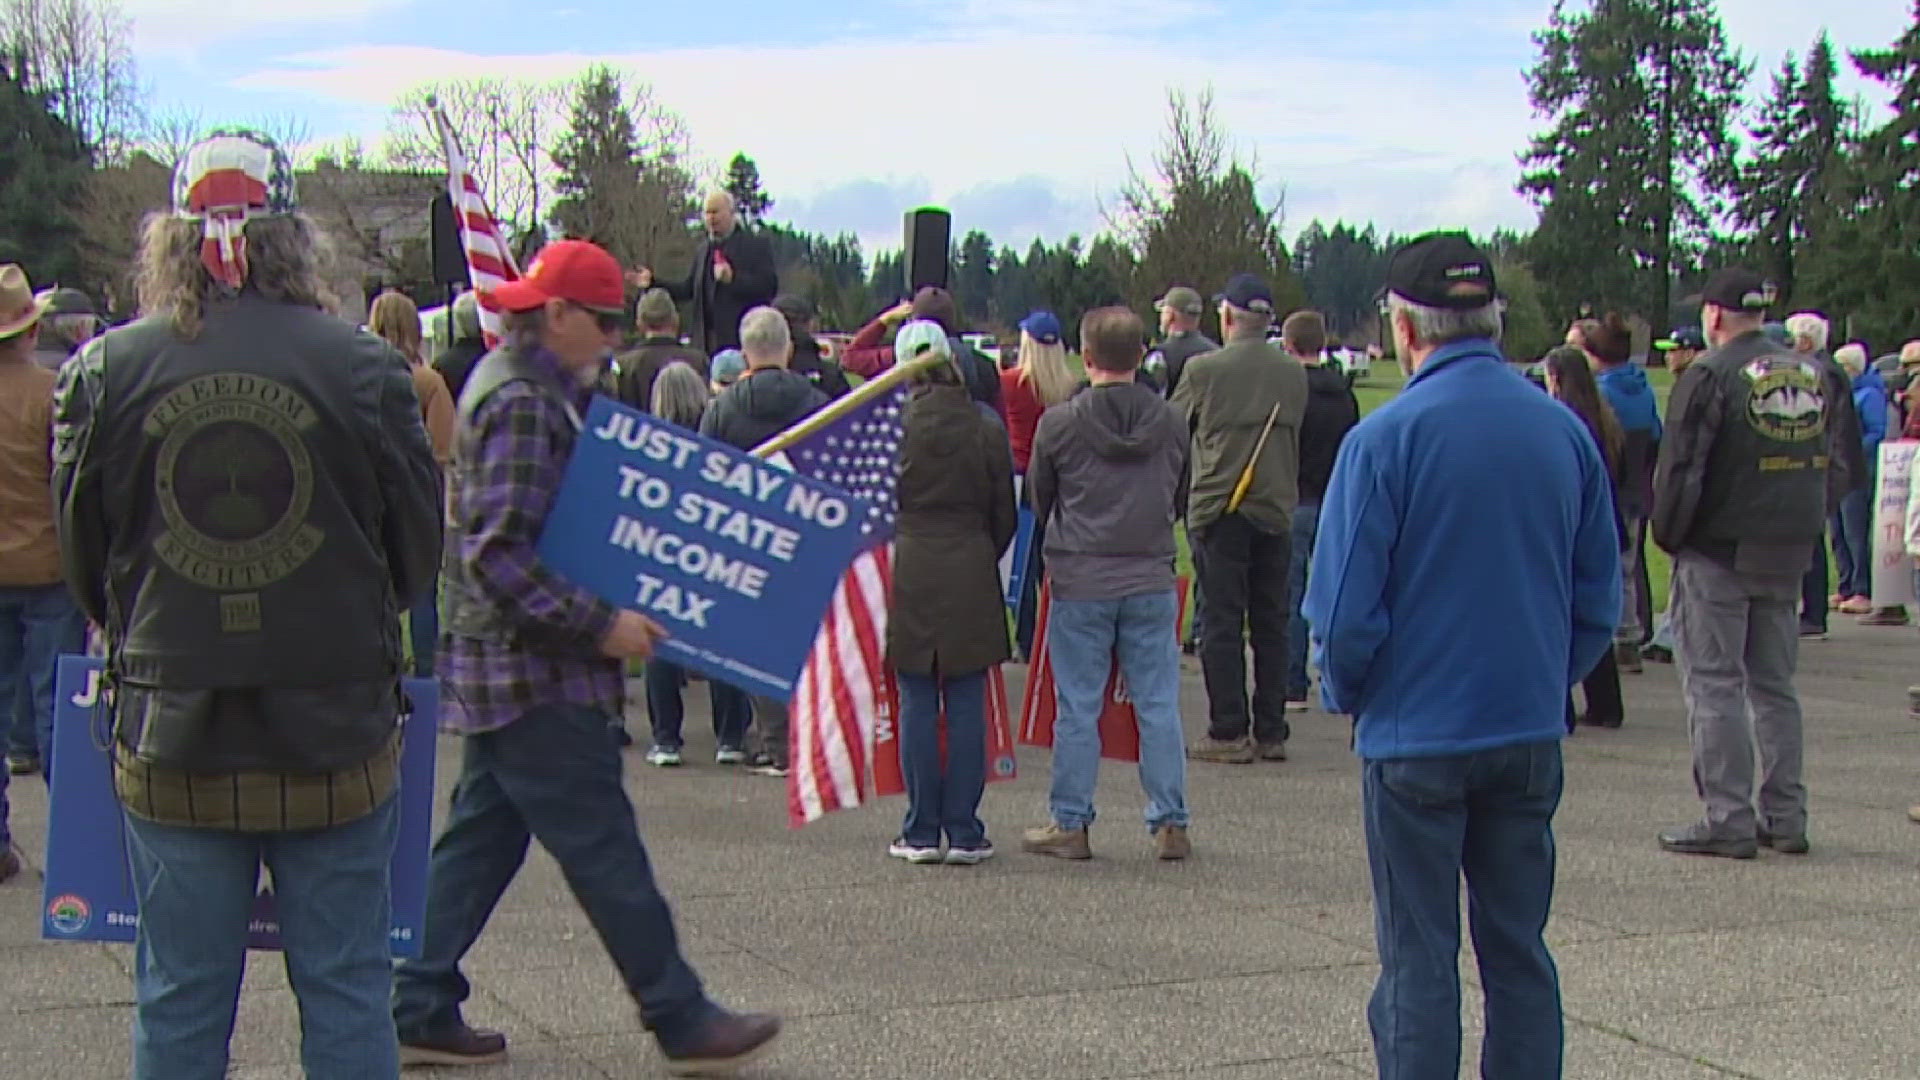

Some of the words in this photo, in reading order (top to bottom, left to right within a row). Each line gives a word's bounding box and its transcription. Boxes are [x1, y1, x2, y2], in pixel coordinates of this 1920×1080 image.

[152, 376, 306, 429] FREEDOM
[594, 412, 698, 470] JUST
[699, 451, 784, 503] SAY
[784, 484, 849, 528] NO
[617, 465, 672, 509] TO
[674, 492, 801, 562] STATE
[164, 533, 313, 585] FIGHTERS
[609, 515, 770, 599] INCOME
[634, 572, 717, 628] TAX
